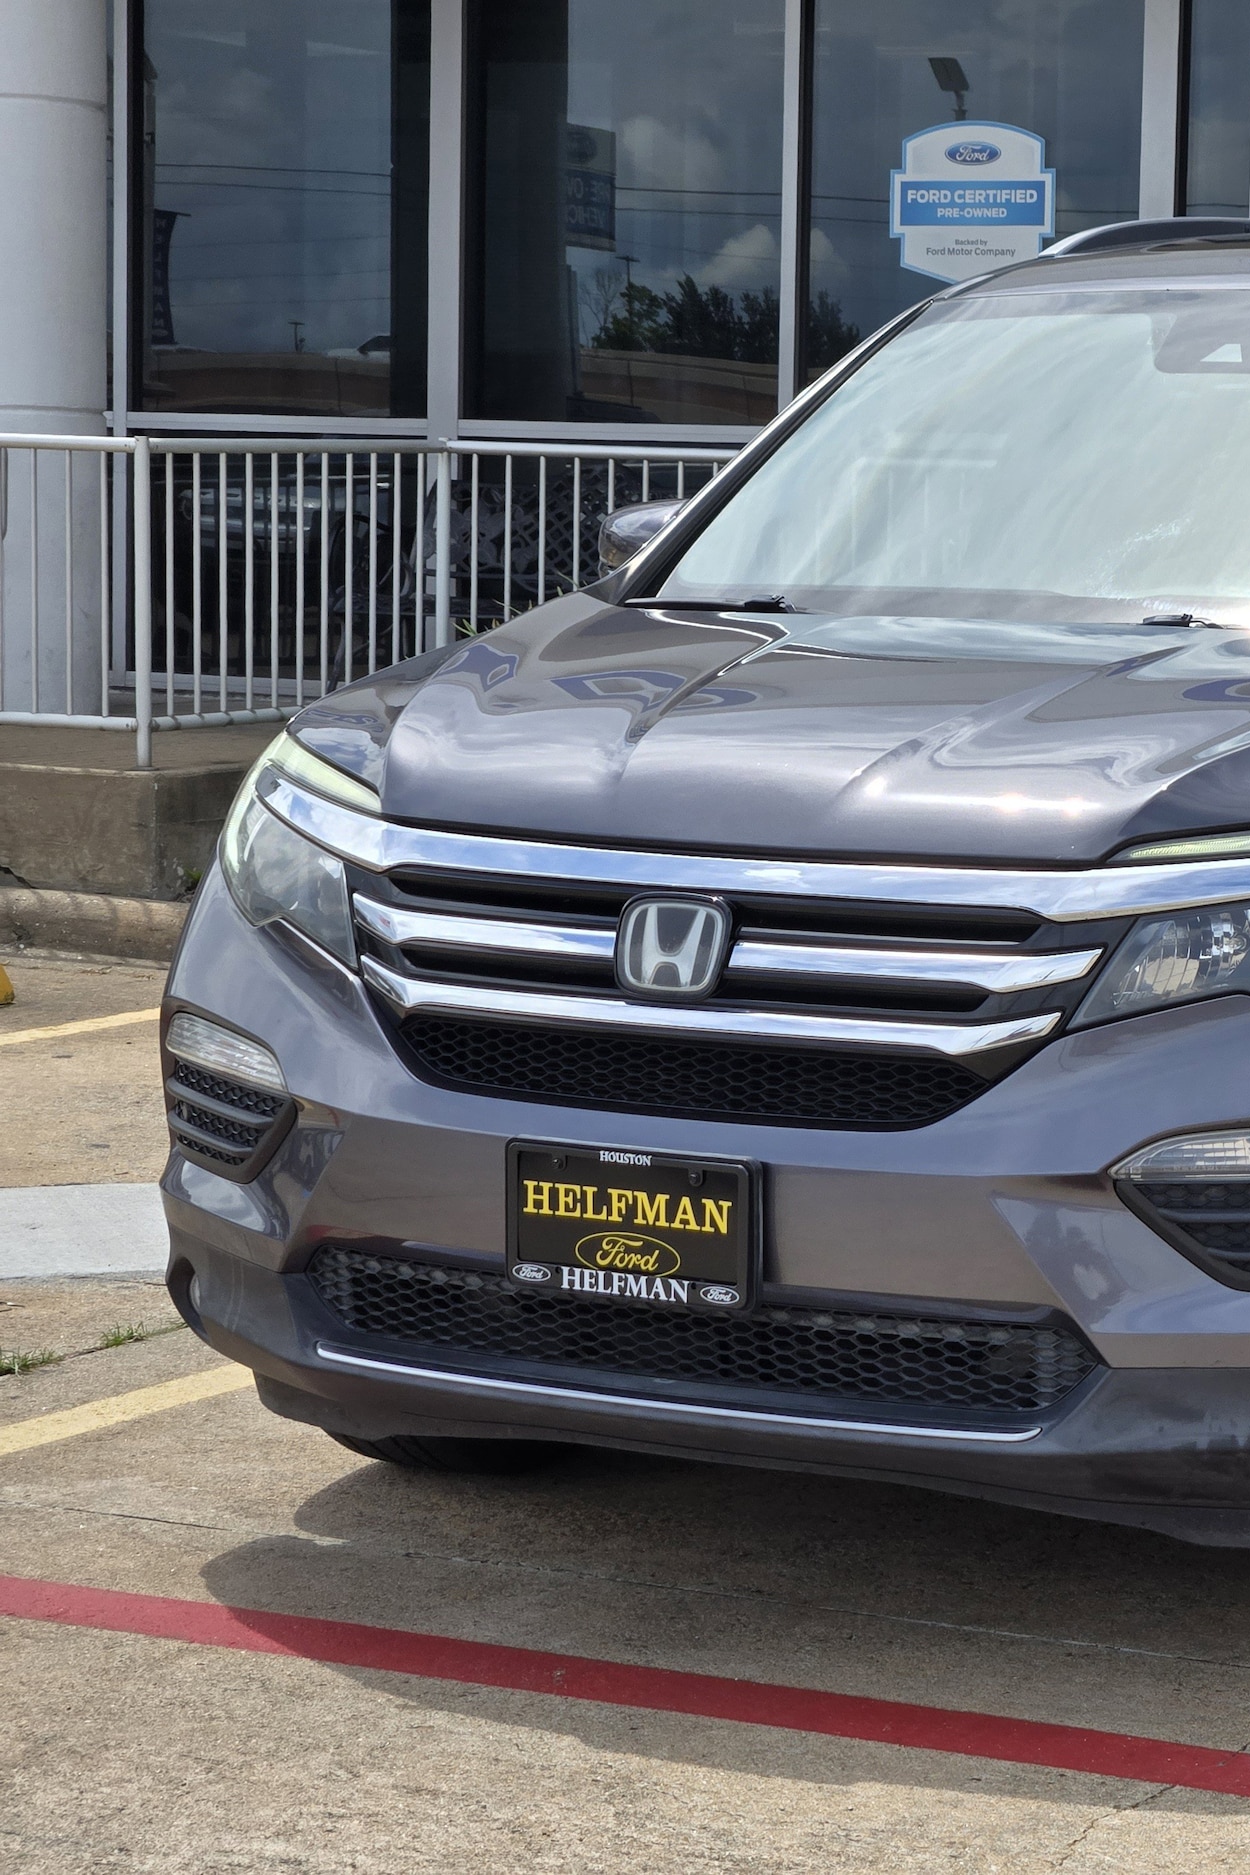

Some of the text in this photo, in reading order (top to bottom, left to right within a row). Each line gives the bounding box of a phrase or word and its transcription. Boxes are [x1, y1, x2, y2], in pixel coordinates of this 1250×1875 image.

[955, 144, 990, 161] Ford
[907, 189, 1038, 204] FORD CERTIFIED
[937, 207, 1007, 218] PRE-OWNED
[954, 238, 988, 247] Backed by
[926, 247, 1016, 258] Ford Motor Company
[599, 1150, 653, 1166] HOUSTON
[523, 1179, 733, 1234] HELFMAN
[595, 1236, 660, 1272] Ford
[518, 1266, 544, 1280] Ford
[560, 1266, 691, 1304] HELFMAN
[707, 1288, 732, 1302] Ford
